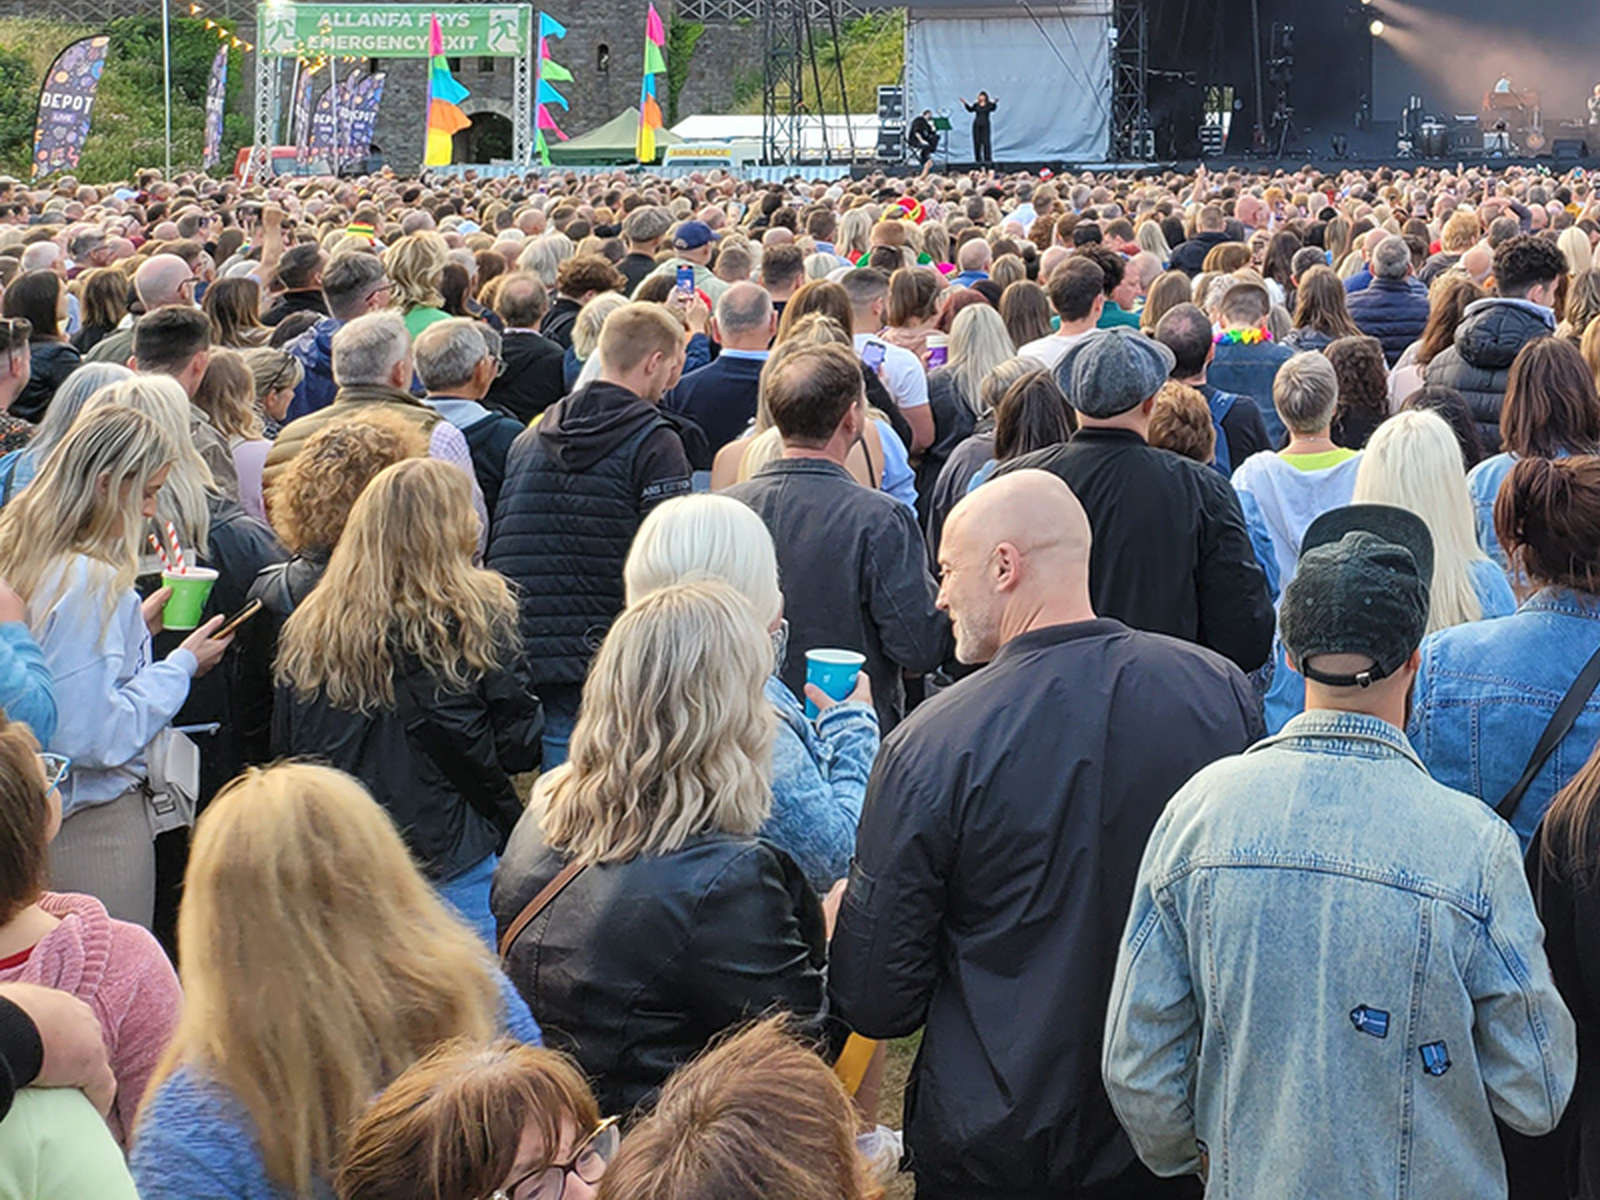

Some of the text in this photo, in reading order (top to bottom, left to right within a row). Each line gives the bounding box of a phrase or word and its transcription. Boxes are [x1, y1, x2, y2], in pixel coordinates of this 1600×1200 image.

[317, 12, 413, 28] ALLANFA
[307, 35, 429, 50] EMERGENCY
[40, 91, 94, 115] DEPOT
